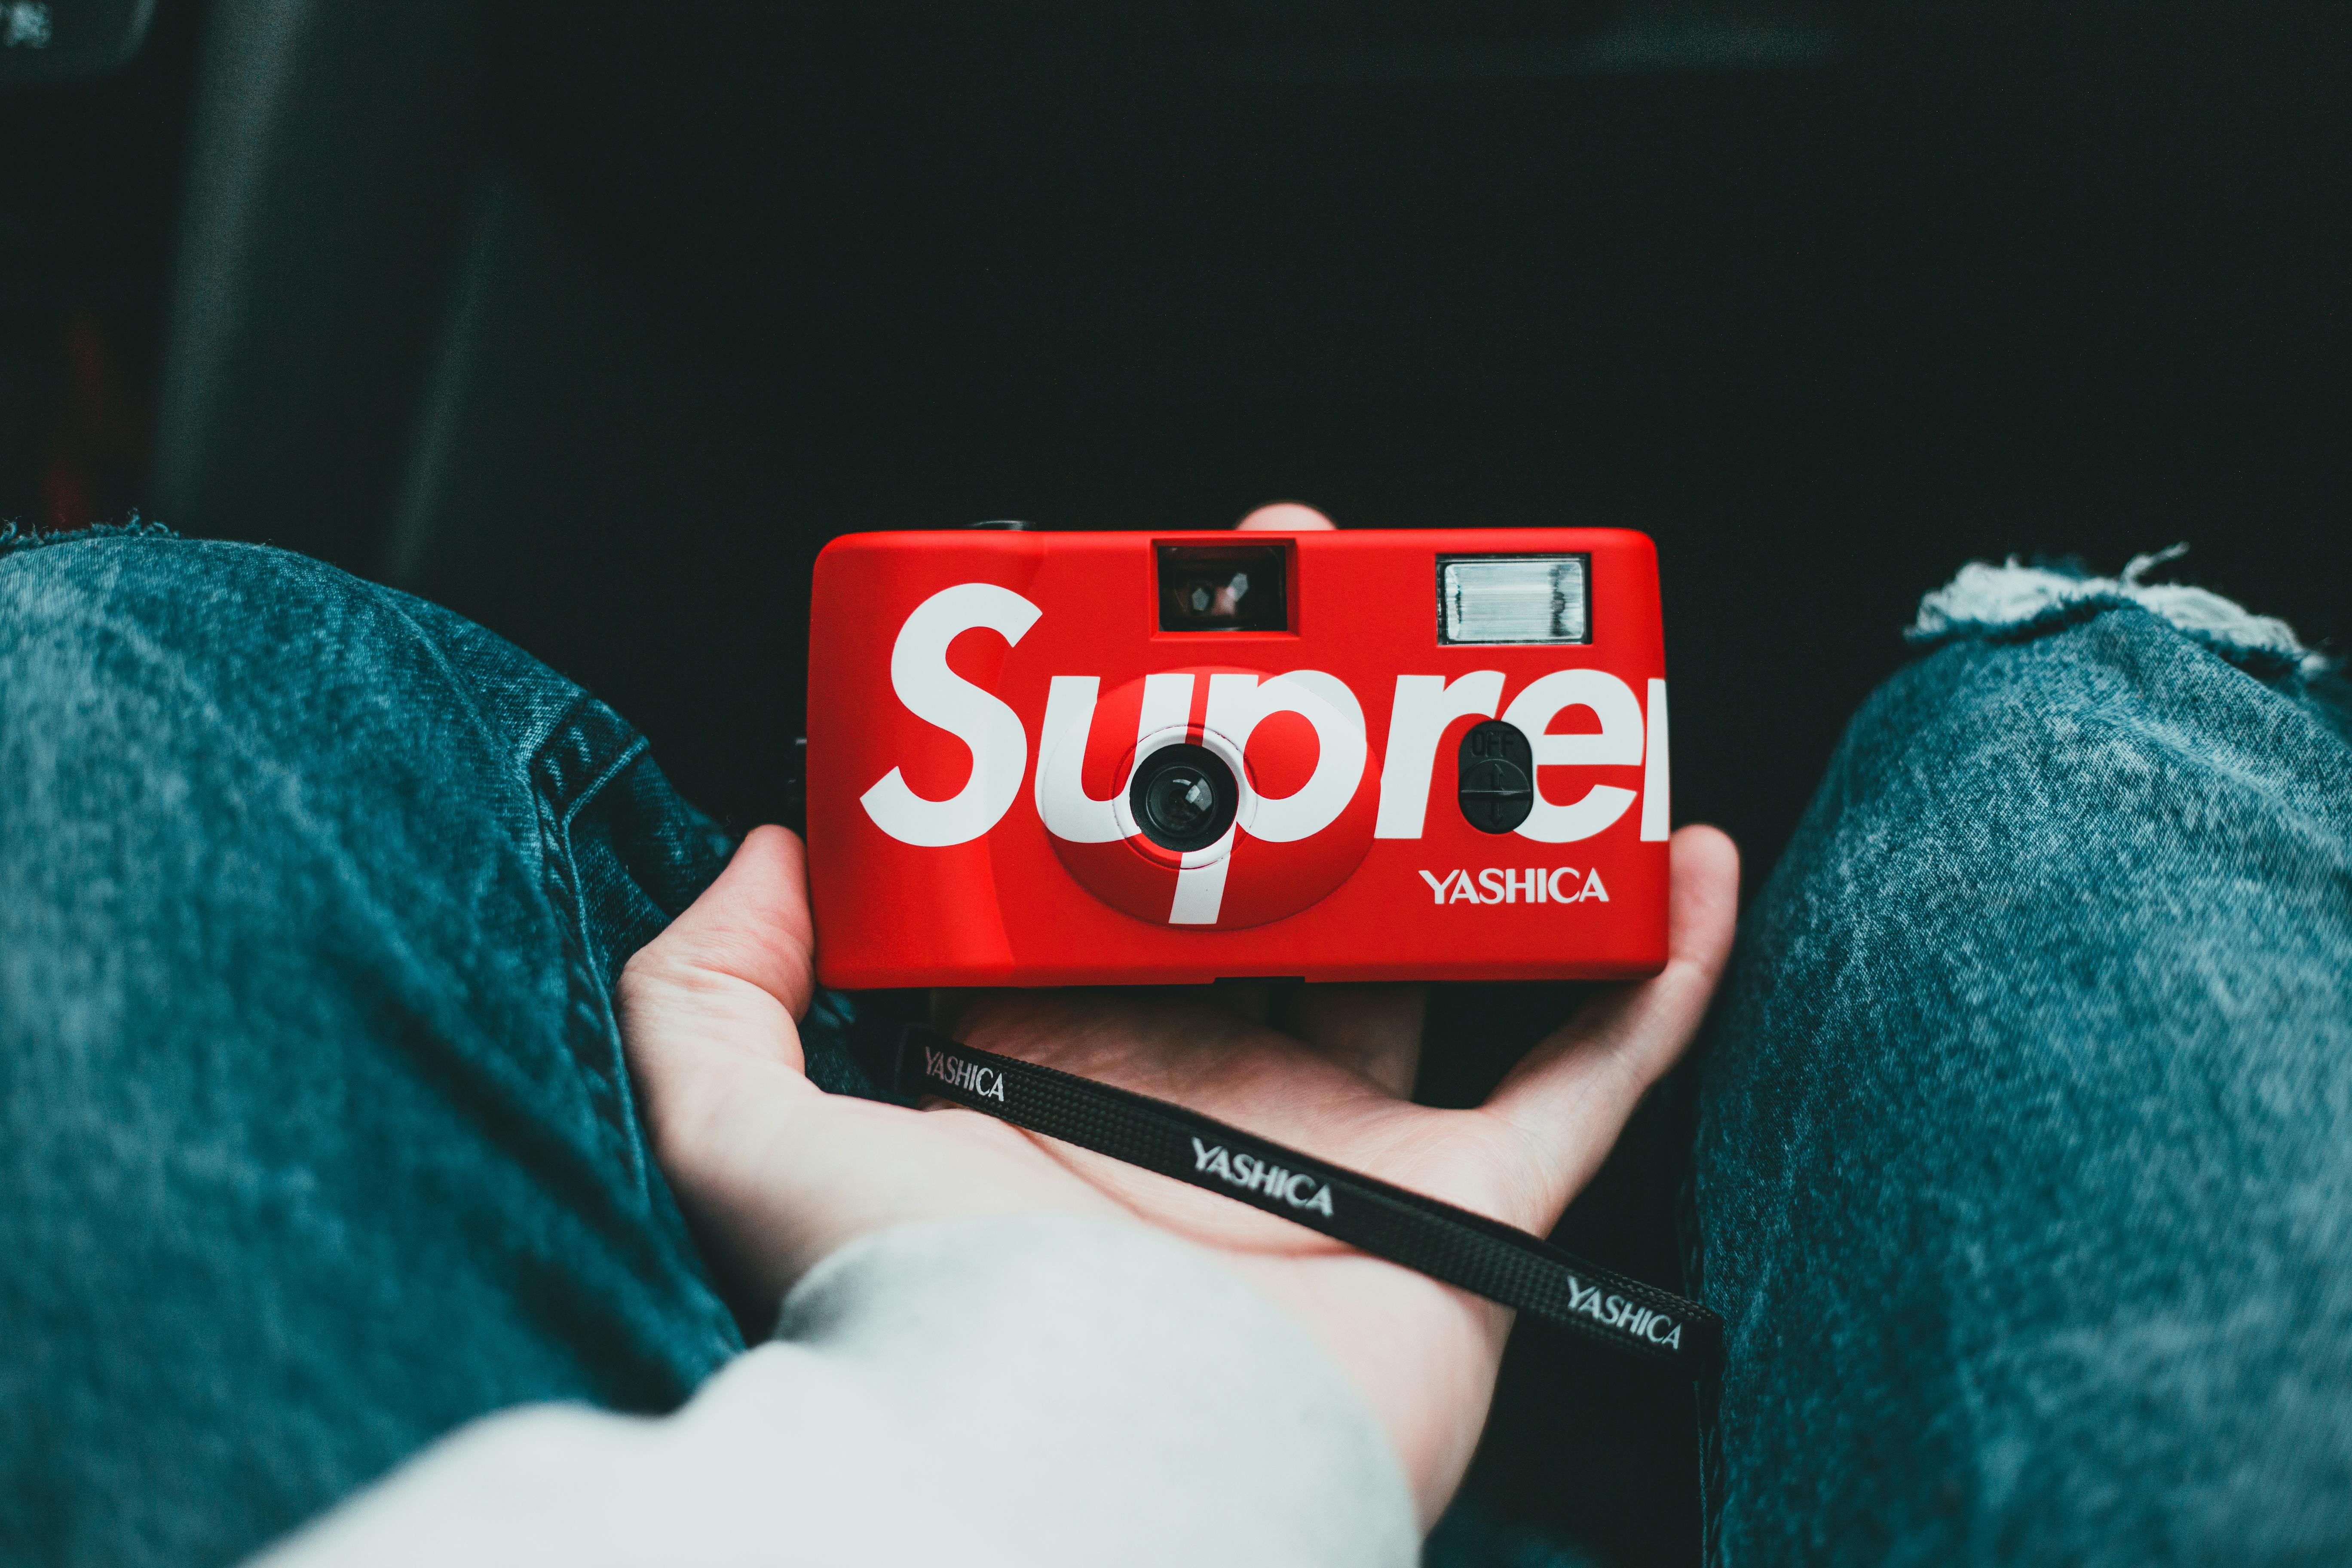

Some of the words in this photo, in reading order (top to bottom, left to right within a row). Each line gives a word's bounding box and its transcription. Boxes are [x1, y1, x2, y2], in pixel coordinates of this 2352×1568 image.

[860, 583, 1669, 924] Supre
[1470, 730, 1514, 758] OFF
[1418, 867, 1609, 904] YASHICA
[925, 1046, 1004, 1102] YASHICA
[1192, 1136, 1334, 1217] YASHICA
[1567, 1275, 1683, 1350] YASHICA
